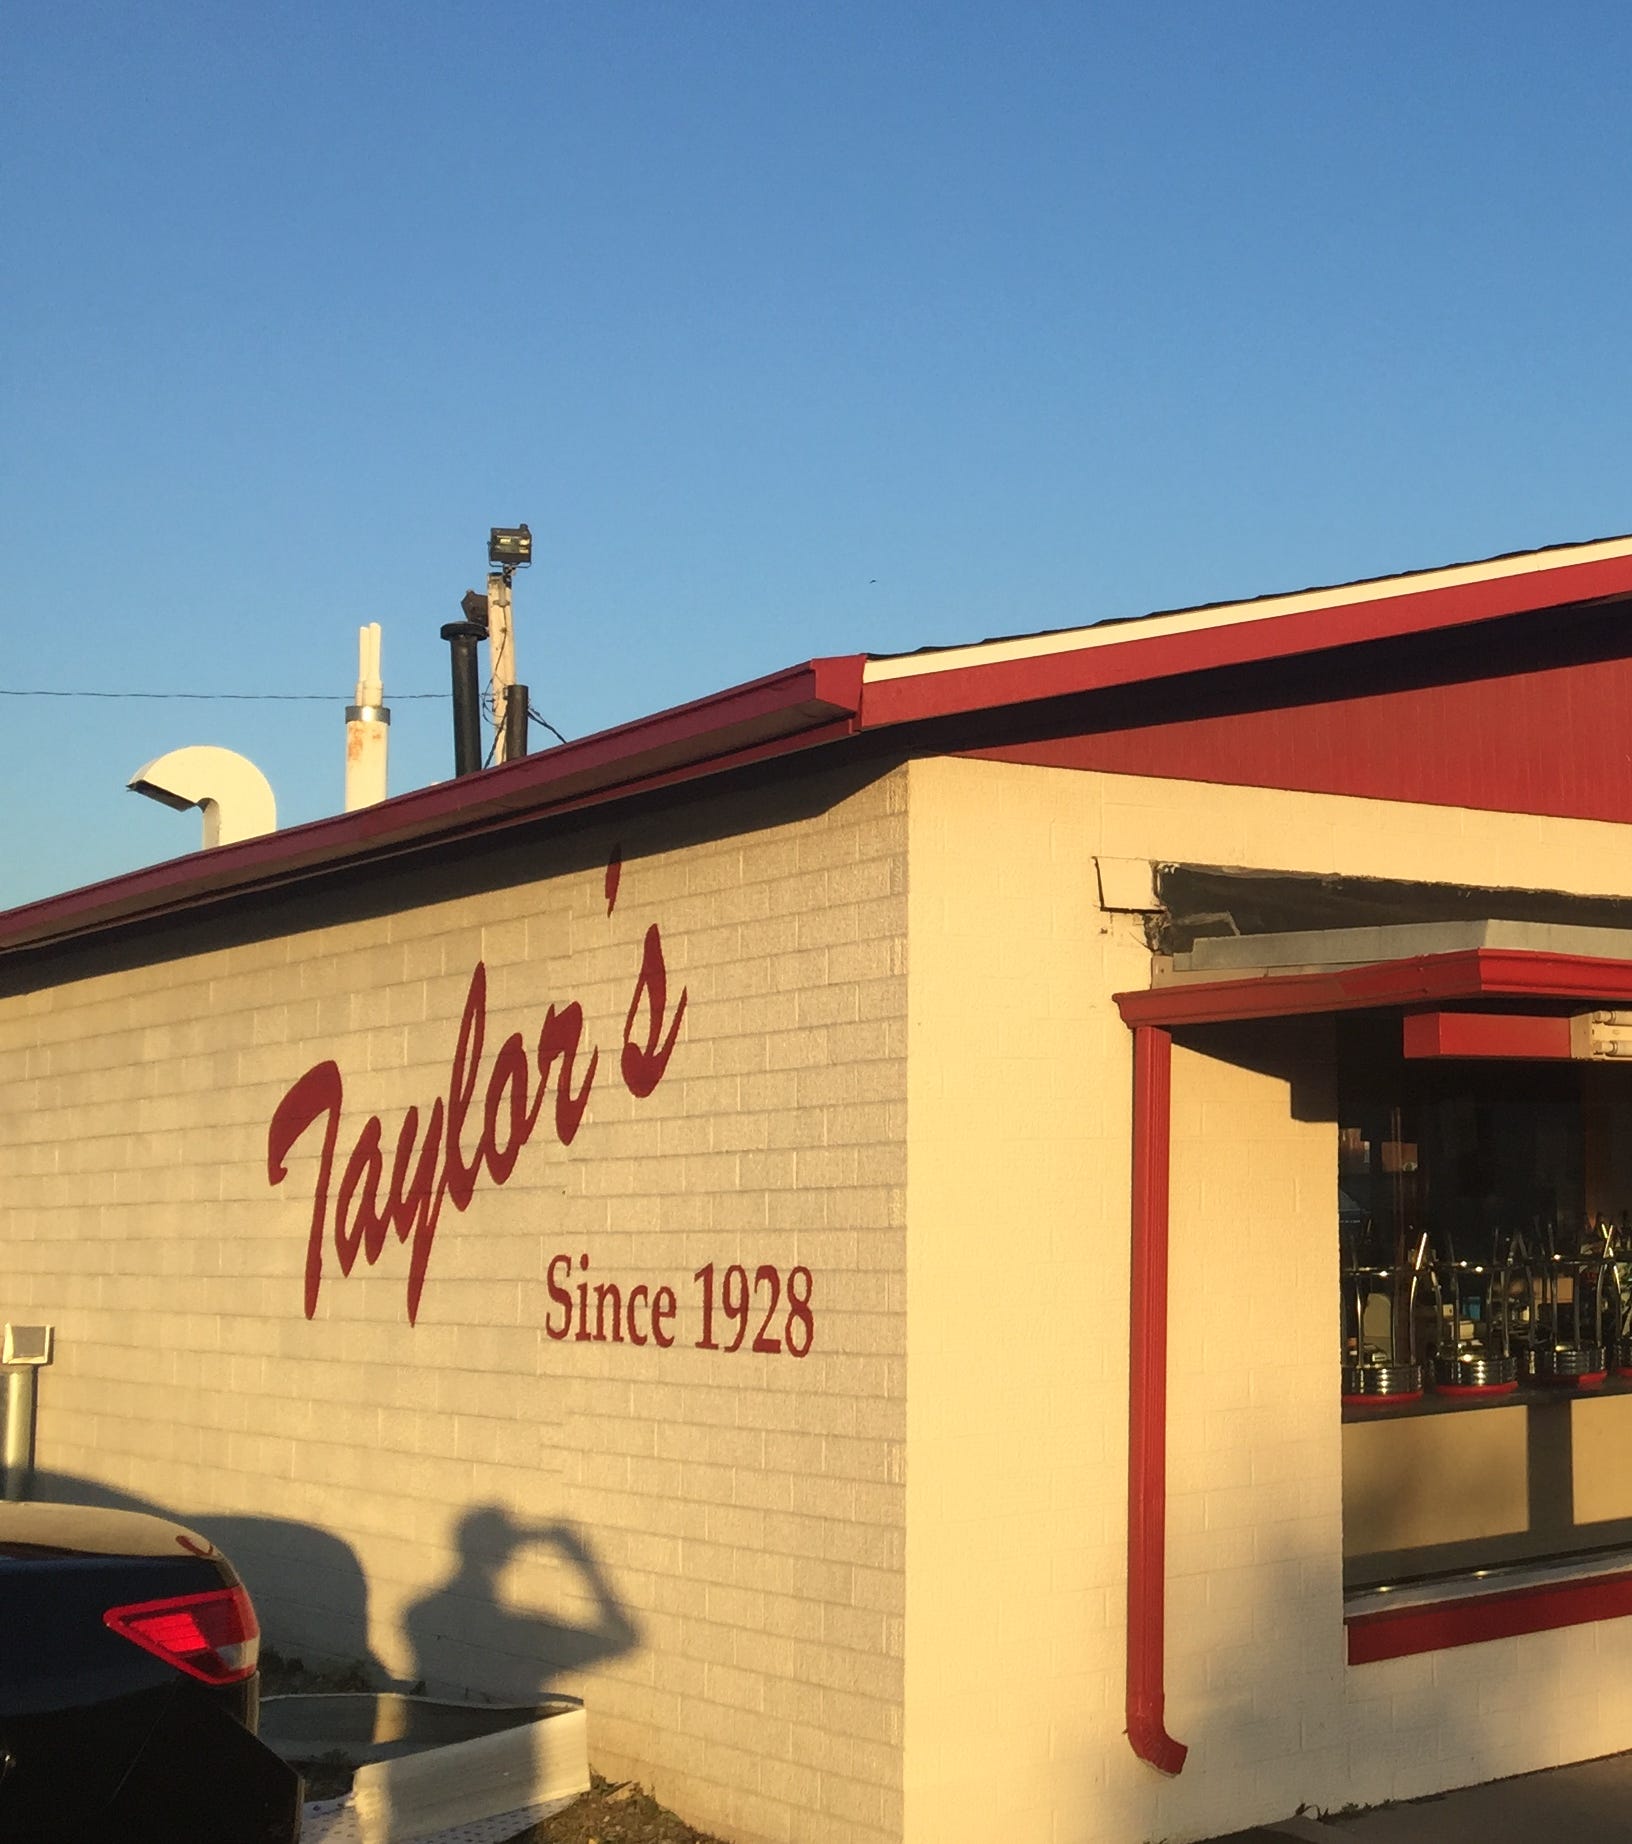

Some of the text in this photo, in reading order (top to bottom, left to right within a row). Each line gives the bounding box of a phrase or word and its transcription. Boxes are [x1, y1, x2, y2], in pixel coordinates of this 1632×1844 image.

[268, 845, 687, 1326] Taylor's
[547, 1254, 813, 1357] Since 1928
